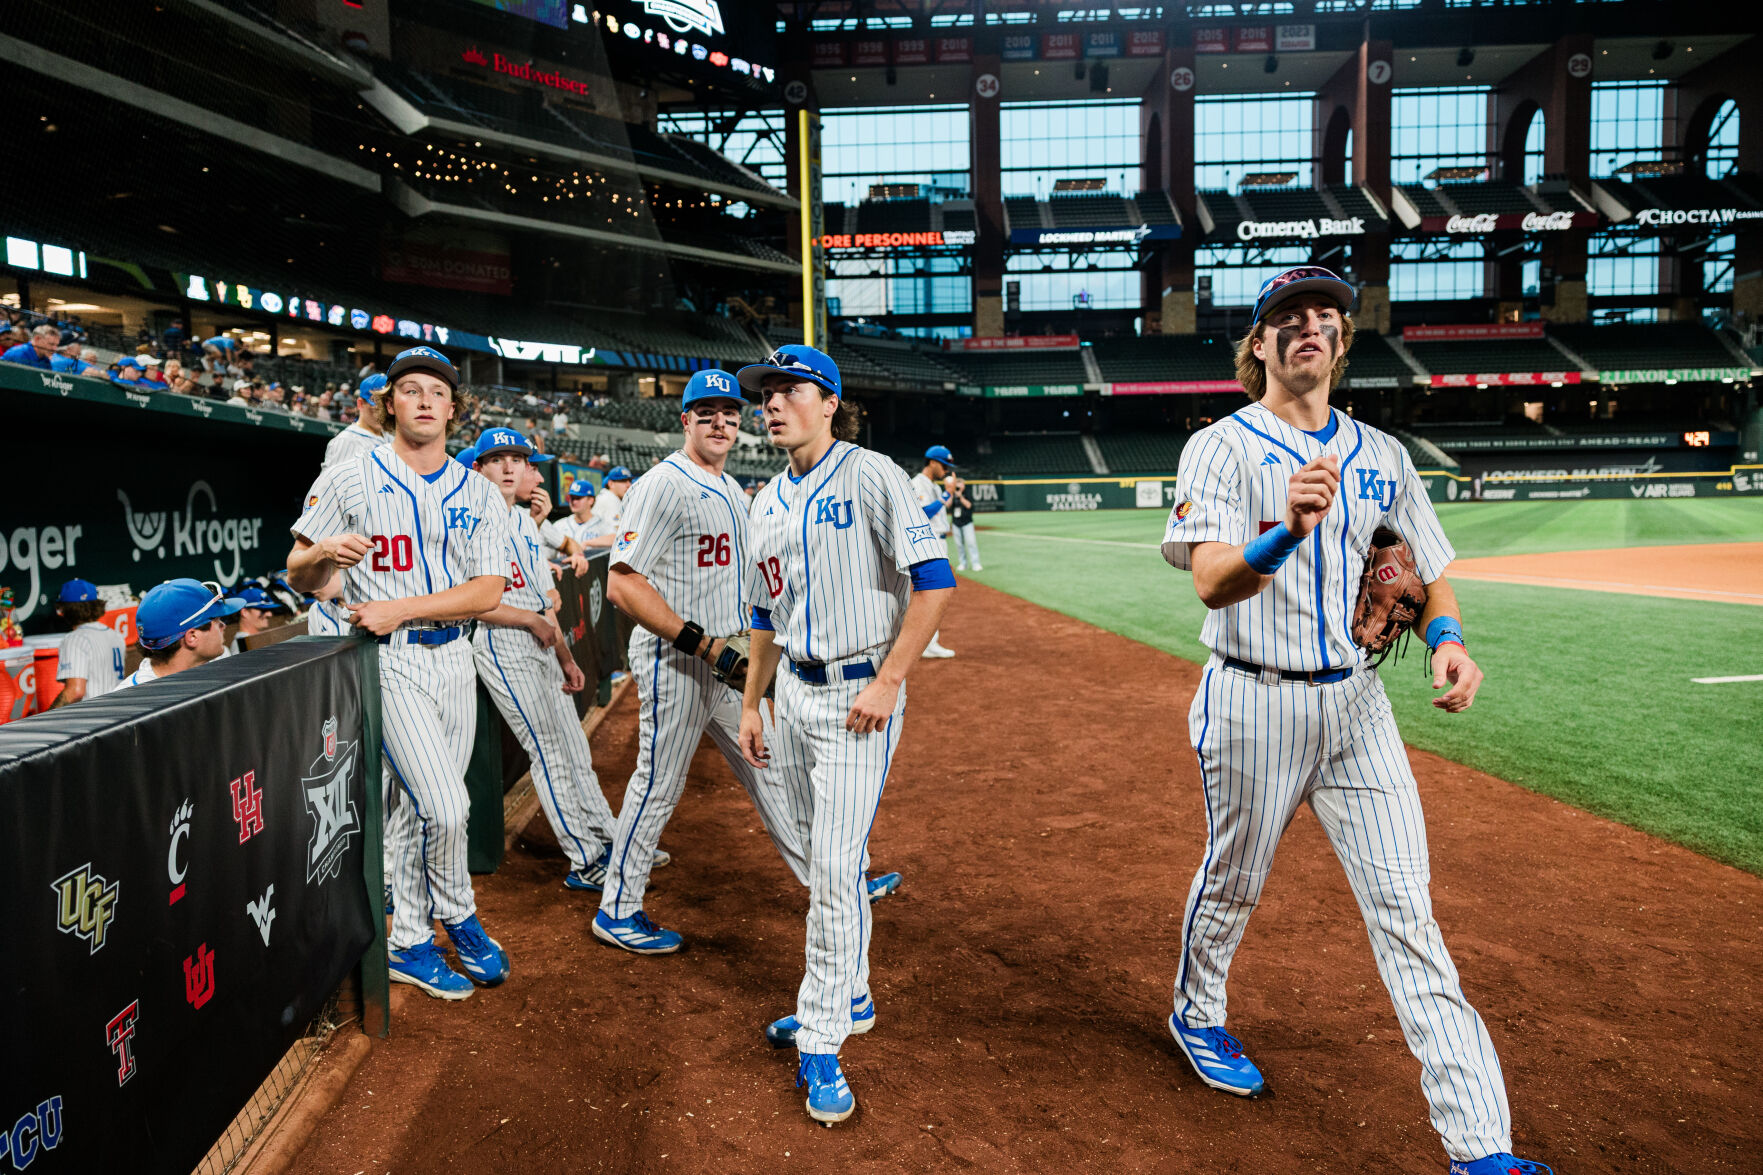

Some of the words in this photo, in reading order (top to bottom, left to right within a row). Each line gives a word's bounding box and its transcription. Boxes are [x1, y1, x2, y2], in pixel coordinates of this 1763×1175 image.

[1174, 69, 1191, 87] 26
[1374, 61, 1384, 80] 7
[979, 77, 997, 95] 34
[1648, 208, 1737, 224] CHOCTAW
[1319, 217, 1365, 235] Bank
[856, 232, 944, 247] PERSONNEL
[705, 374, 730, 392] KU
[1615, 370, 1666, 383] LUXOR
[1673, 367, 1748, 381] STAFFING
[493, 432, 515, 445] KU
[1481, 469, 1568, 484] LOCKHEED
[1571, 467, 1638, 482] MARTIN
[972, 484, 998, 501] UTA
[1046, 494, 1102, 504] ESTRELLA
[1356, 468, 1397, 513] KU
[814, 495, 854, 530] KU
[1051, 501, 1098, 511] JALISCO
[448, 507, 481, 541] KU
[172, 480, 263, 588] Kroger
[371, 534, 414, 572] 20
[697, 533, 731, 568] 26
[757, 556, 784, 599] 18
[114, 613, 128, 641] G
[20, 666, 36, 695] G
[167, 822, 190, 885] C
[54, 864, 120, 953] UCF
